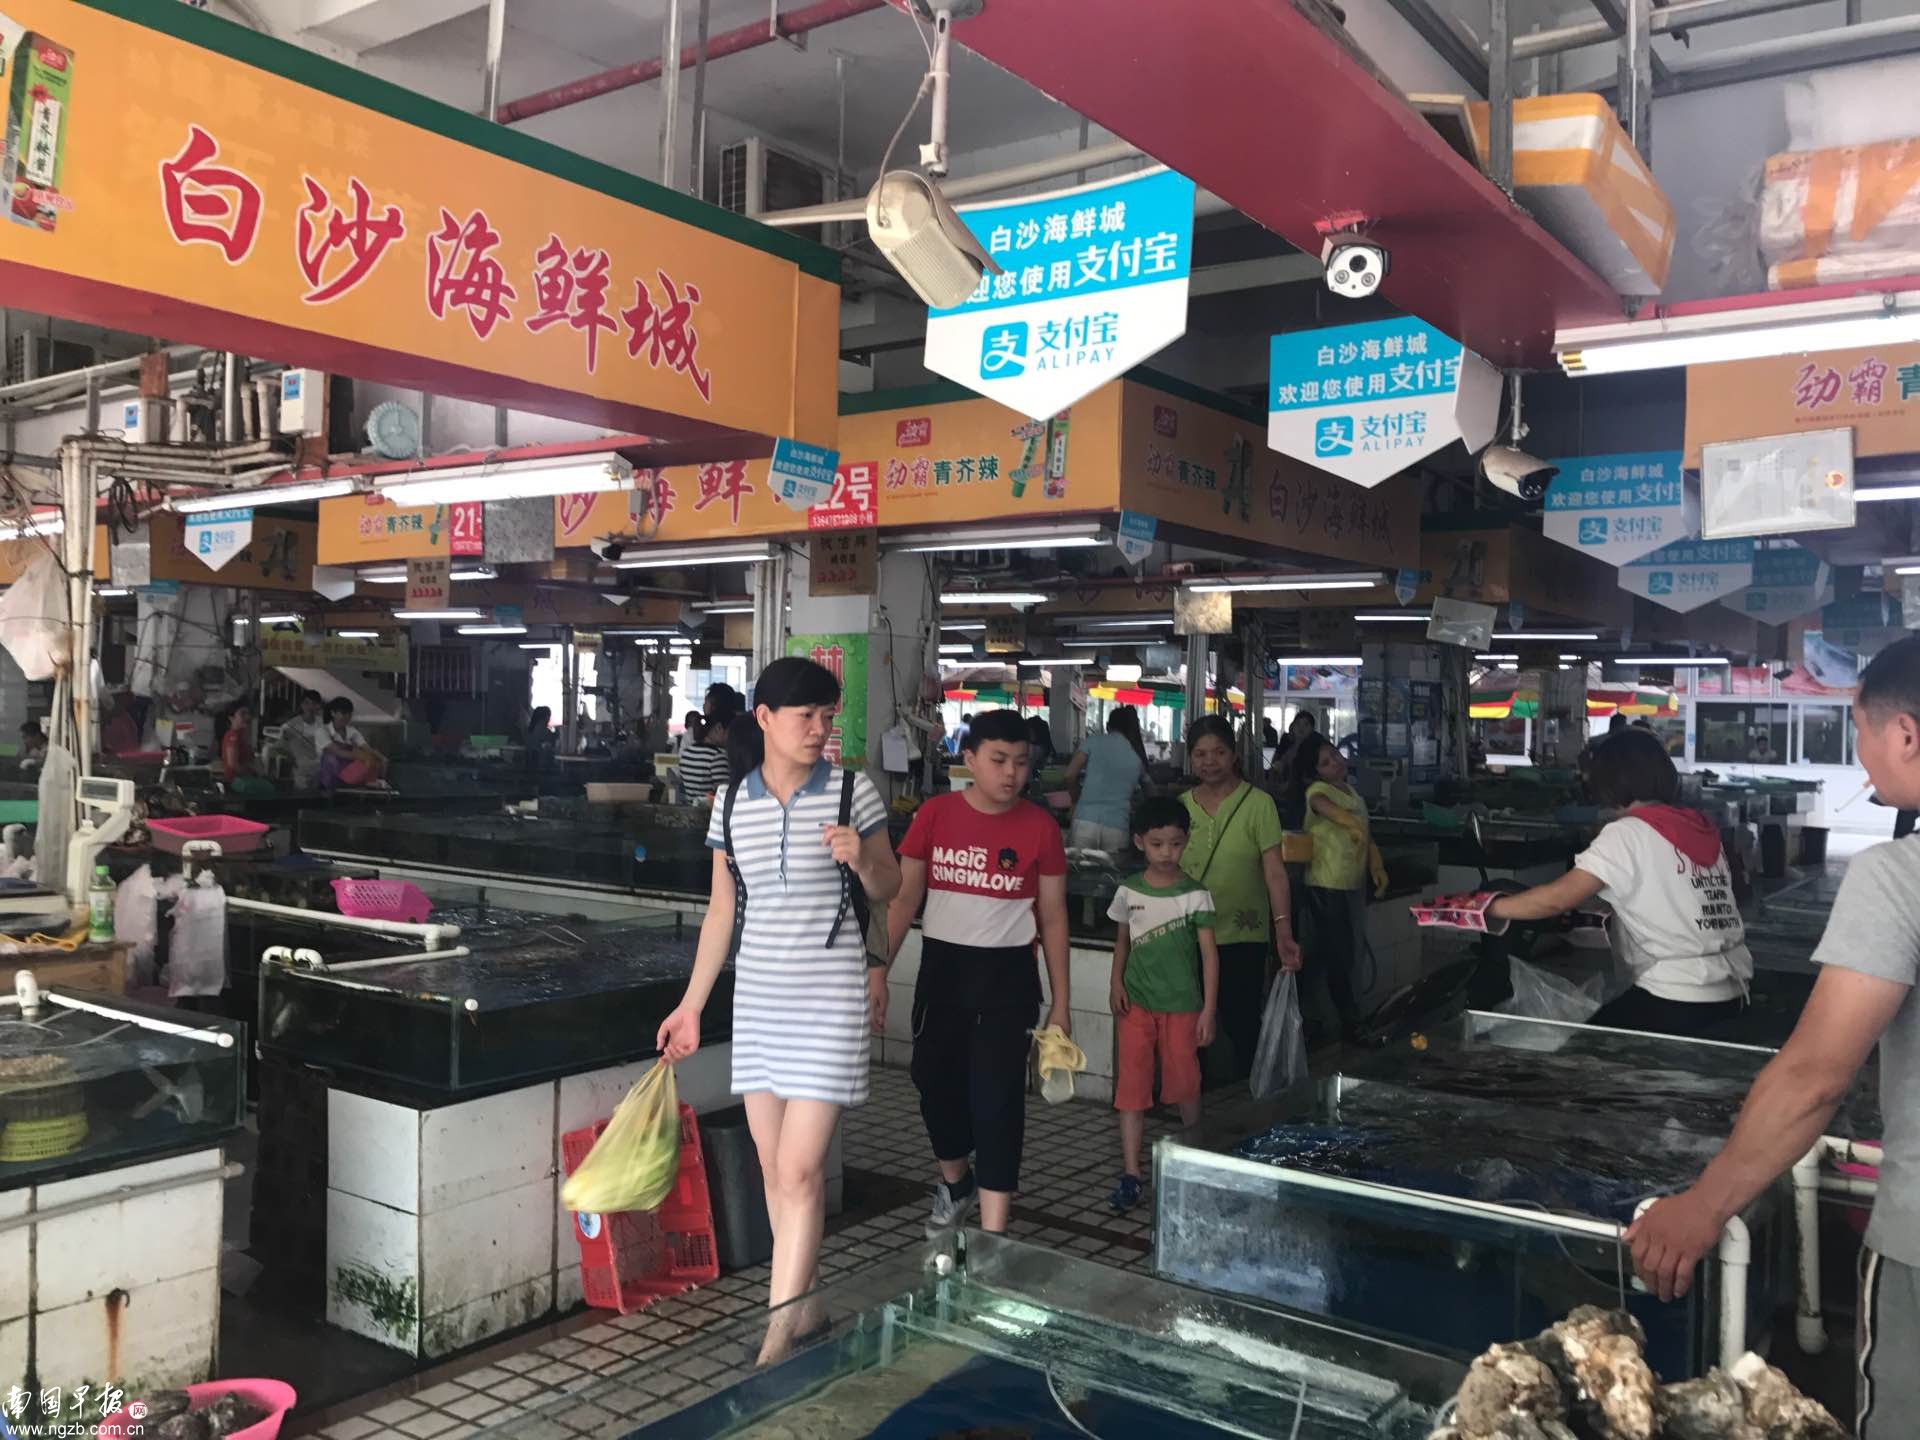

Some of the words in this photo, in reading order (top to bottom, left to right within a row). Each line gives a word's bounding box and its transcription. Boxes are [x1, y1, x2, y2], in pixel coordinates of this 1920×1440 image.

[989, 201, 1127, 255] 白沙海鲜城
[160, 124, 712, 403] 白沙海鲜城
[963, 231, 1178, 305] 迎您使用支付宝
[1035, 311, 1119, 355] 支付宝
[1036, 346, 1116, 371] ALIPAY
[1316, 332, 1428, 367] 白沙海鲜城
[1360, 410, 1427, 441] 支付宝
[1362, 436, 1426, 453] ALIPAY
[885, 455, 1000, 489] 劲霸青芥辣
[1580, 463, 1665, 483] 白沙海鲜城
[813, 466, 873, 511] 2号
[1551, 481, 1682, 507] 欢迎您使用支付
[453, 506, 482, 538] 21
[1612, 514, 1664, 535] 支付宝
[932, 845, 988, 871] MAGIC
